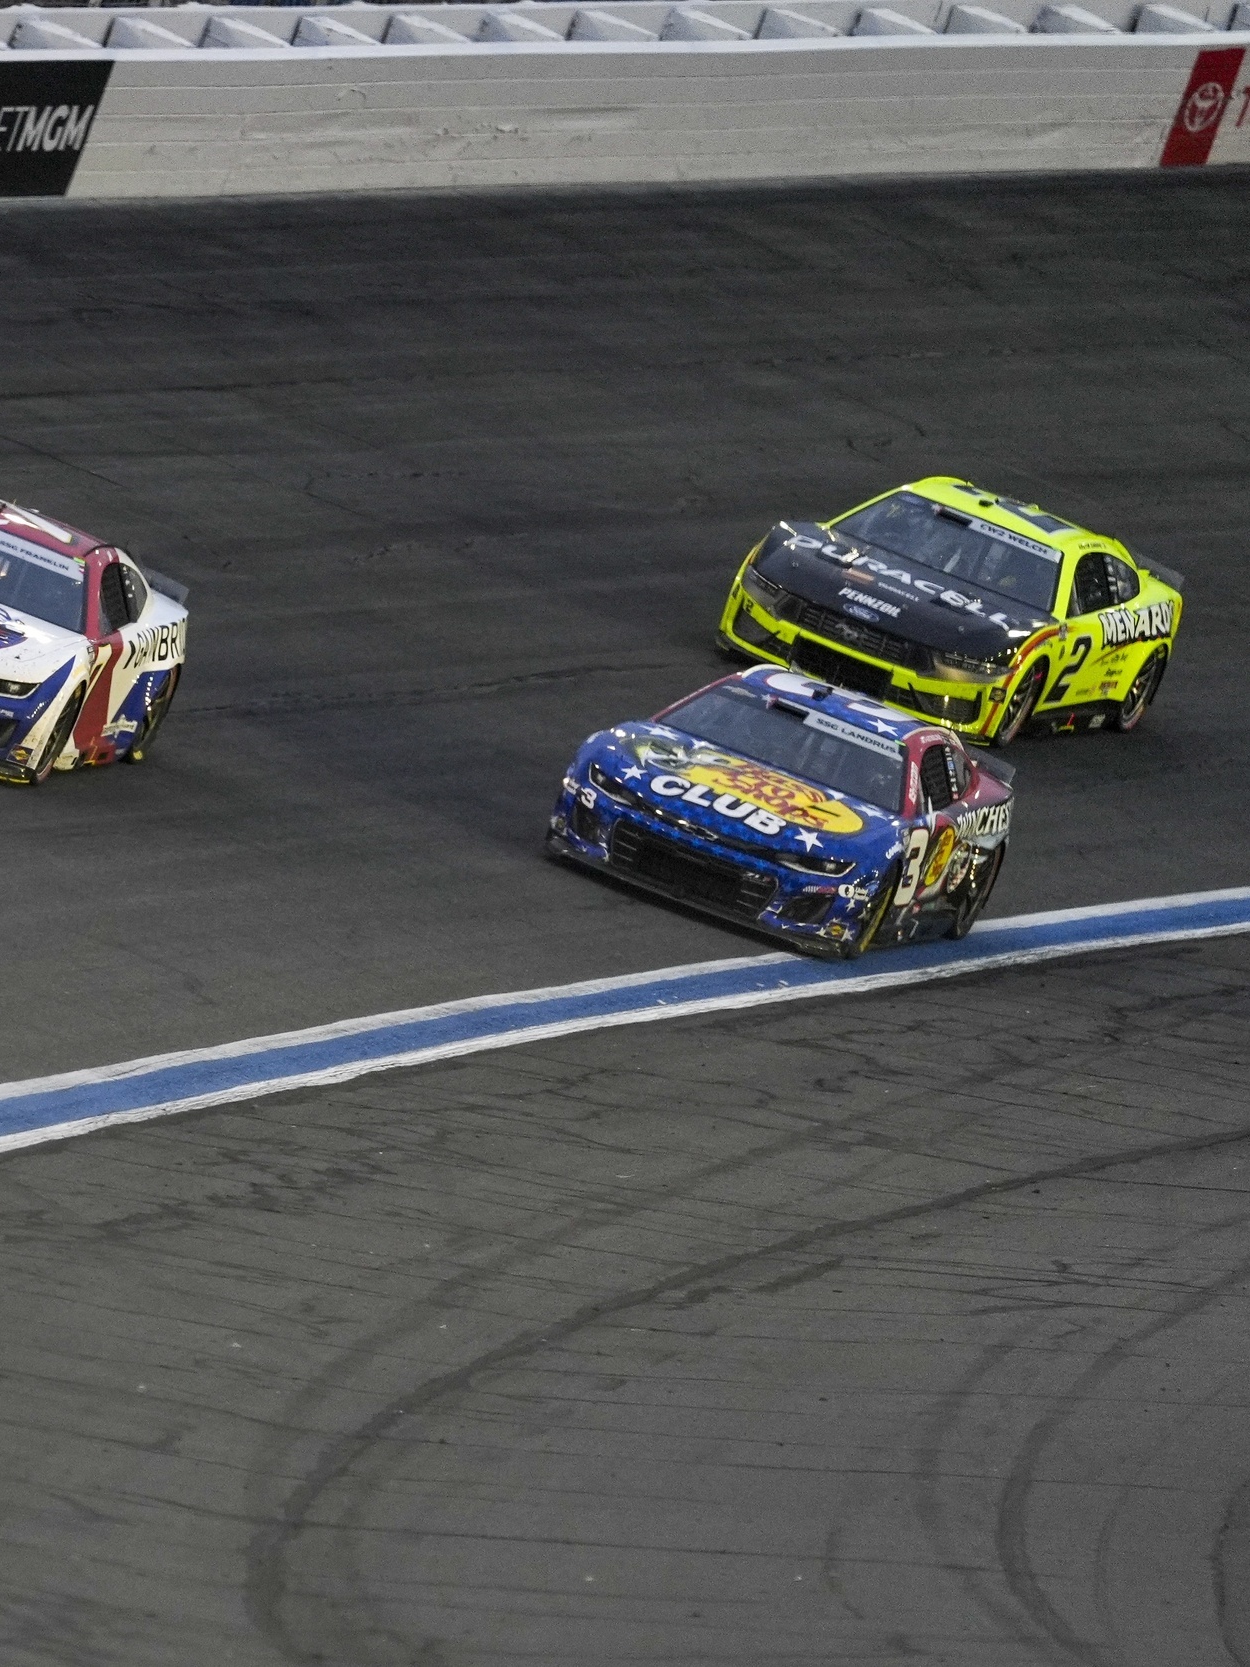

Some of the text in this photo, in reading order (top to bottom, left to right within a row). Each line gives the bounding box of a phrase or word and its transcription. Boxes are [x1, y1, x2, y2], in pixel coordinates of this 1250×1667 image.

[1008, 534, 1048, 555] WELCH
[19, 546, 69, 571] FRANKLIN
[838, 587, 901, 618] PENNZOIL
[841, 728, 897, 753] LANDRUS
[580, 787, 597, 809] 3
[650, 775, 787, 835] CLUB
[894, 827, 929, 906] 3
